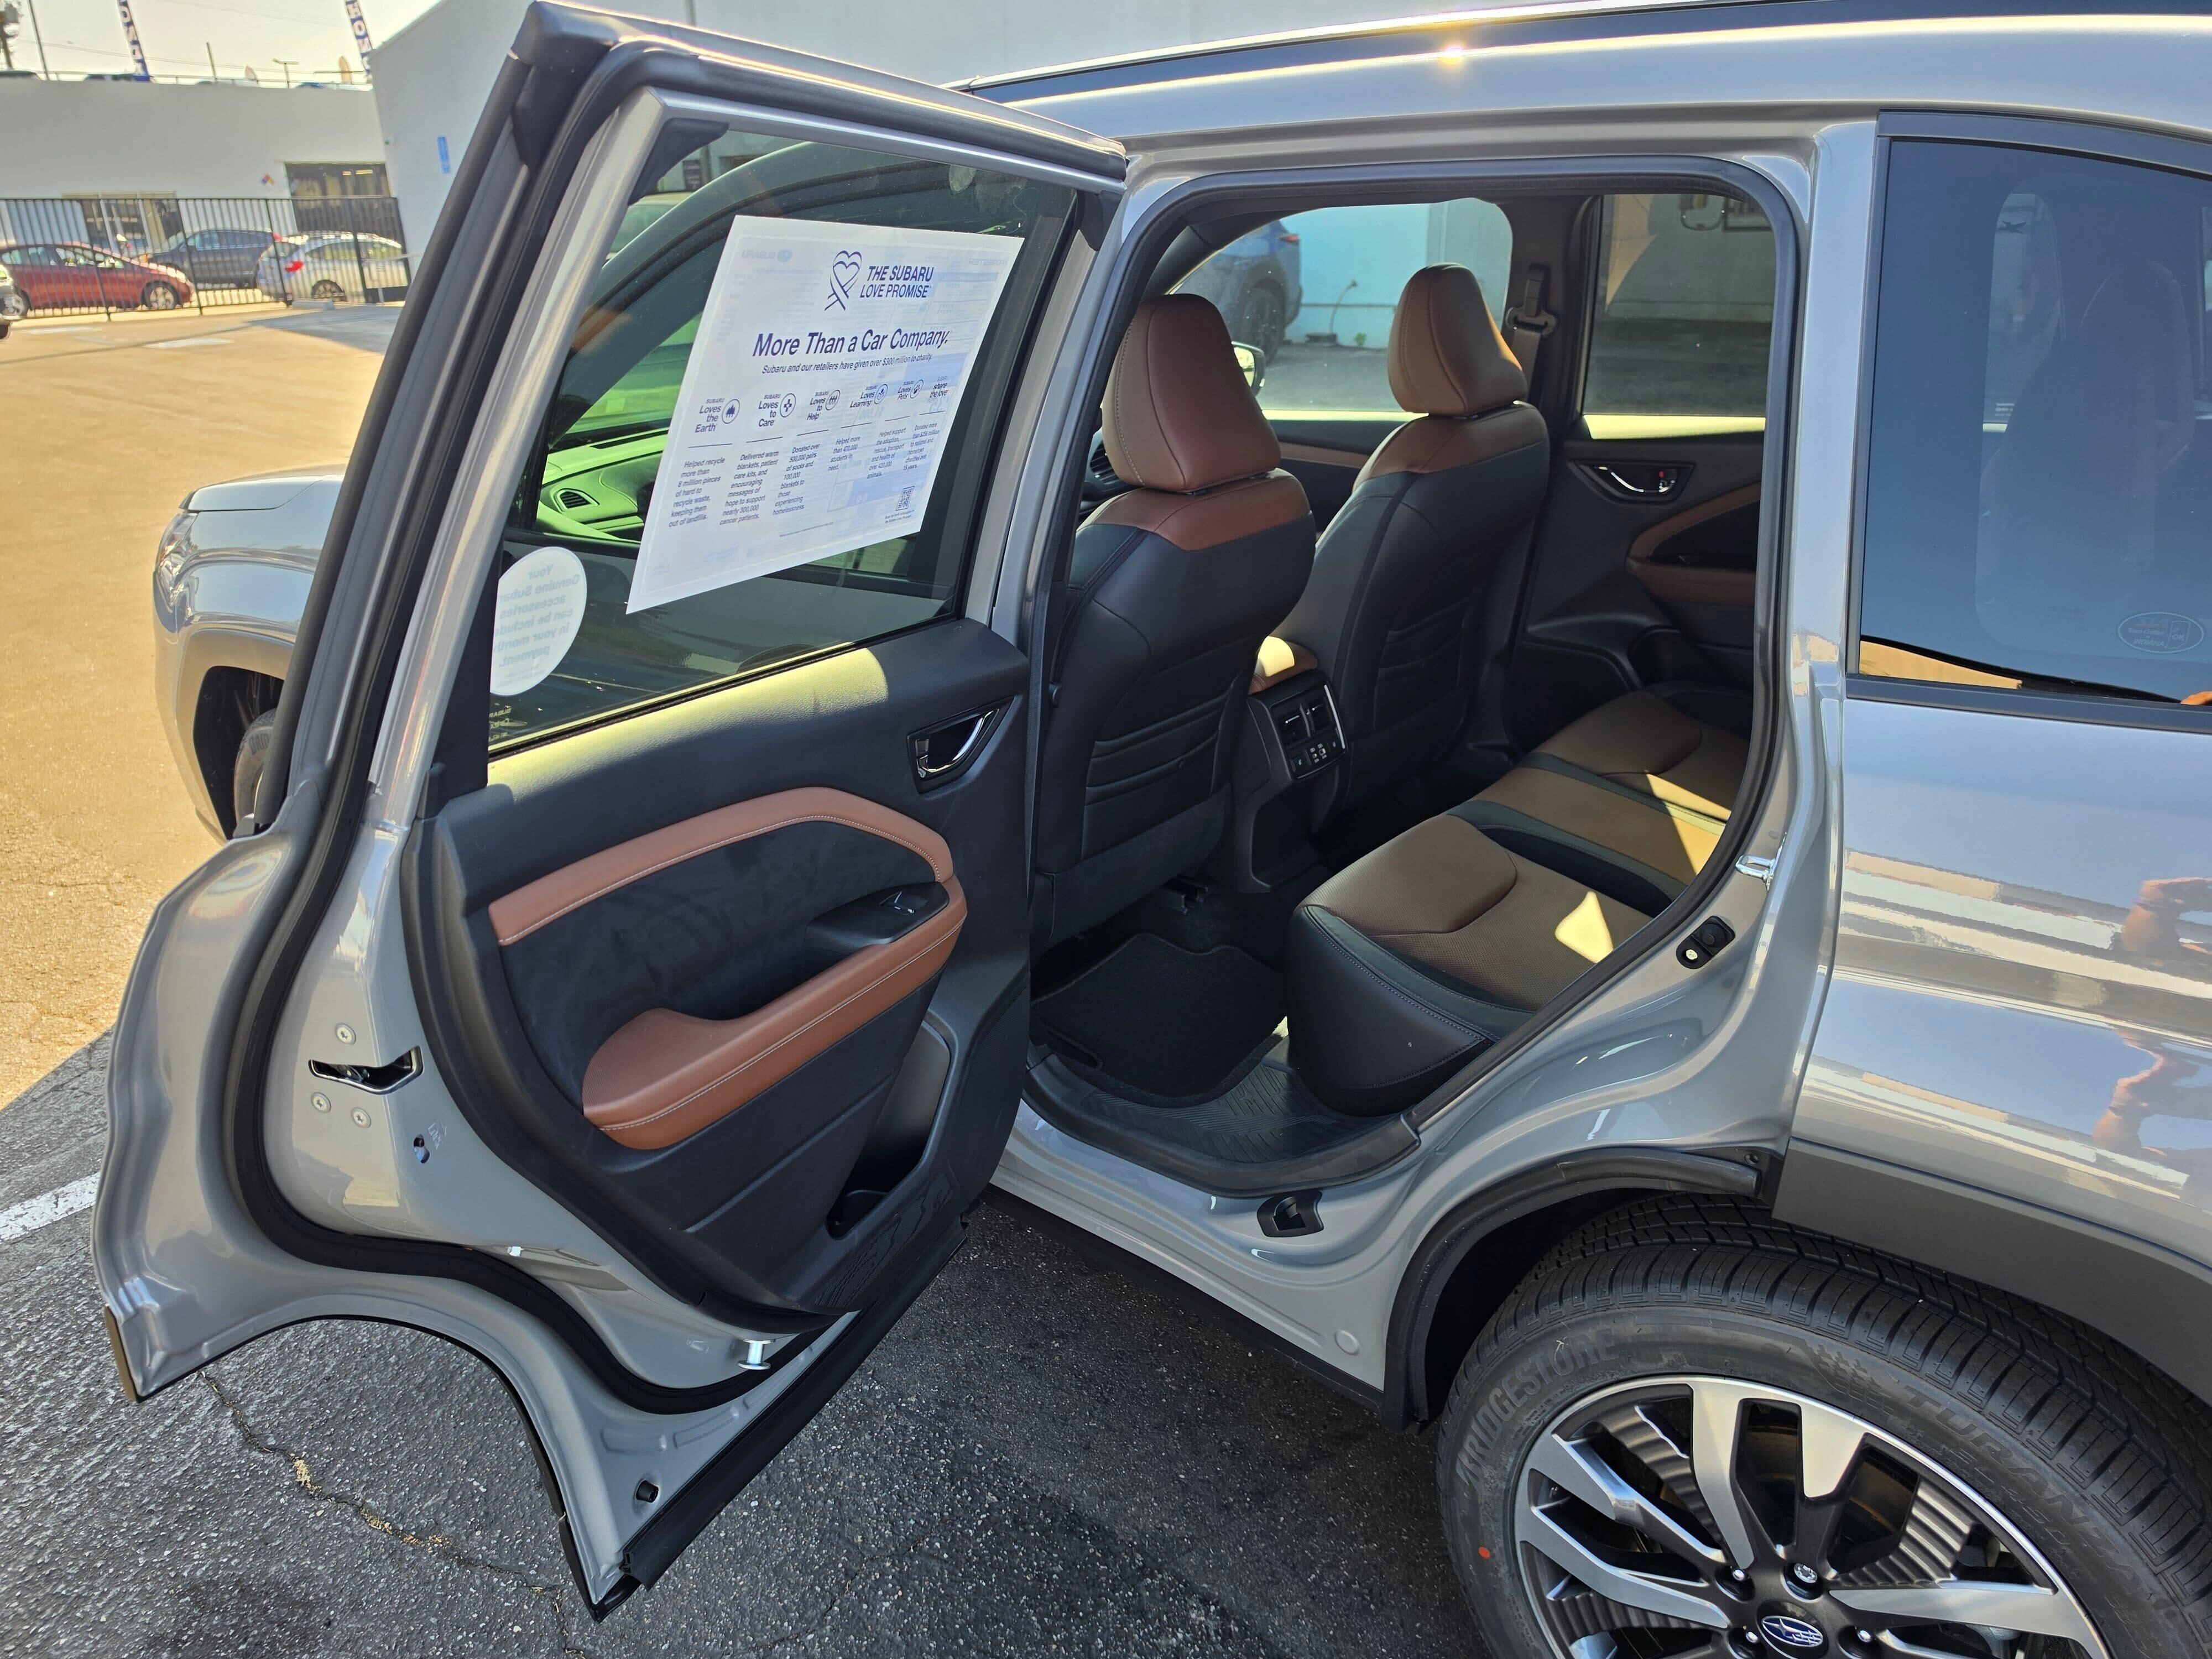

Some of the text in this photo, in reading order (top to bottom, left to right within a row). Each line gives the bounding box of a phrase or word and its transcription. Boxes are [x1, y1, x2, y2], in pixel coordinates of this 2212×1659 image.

[867, 265, 934, 282] THE SUBARU
[860, 284, 930, 299] LOVE PROMISE
[752, 328, 950, 357] More Than a Car Company.
[762, 364, 786, 374] Subaru
[787, 363, 801, 372] and
[813, 362, 838, 371] retailers
[839, 361, 853, 369] have
[854, 359, 869, 371] given
[883, 357, 895, 366] $300
[895, 355, 911, 364] million
[911, 354, 916, 362] to
[916, 352, 932, 362] charity.
[933, 382, 947, 390] share
[930, 388, 948, 398] the love
[758, 401, 779, 410] Loves
[810, 398, 826, 406] Loves
[850, 399, 873, 409] Learning
[699, 405, 722, 414] Loves
[769, 410, 777, 418] to
[706, 413, 719, 422] the
[806, 412, 820, 421] Help
[695, 422, 716, 433] Earth
[758, 418, 774, 427] Care
[915, 423, 928, 431] Donated
[879, 426, 907, 437] Helped support
[836, 436, 850, 446] Helped
[792, 444, 811, 453] Donated
[740, 452, 765, 461] Delivered
[806, 452, 817, 461] pairs
[830, 454, 848, 463] students
[879, 453, 890, 461] health
[684, 457, 725, 468] Helped recycle
[737, 459, 779, 470] blankets, patient
[792, 462, 805, 471] socks
[682, 478, 702, 487] million
[702, 476, 721, 486] pieces
[731, 479, 763, 488] encouraging
[780, 481, 799, 489] blankets
[675, 489, 682, 497] of
[682, 487, 696, 496] hard
[727, 488, 754, 498] messages
[673, 497, 693, 508] recycle
[745, 494, 766, 504] support
[775, 495, 804, 508] experiencing
[671, 508, 693, 518] keeping
[722, 508, 739, 517] nearly
[669, 519, 679, 528] out
[679, 517, 686, 526] of
[719, 517, 738, 525] cancer
[2132, 637, 2166, 647] INDIANA
[2172, 634, 2185, 642] OK
[1455, 1328, 1621, 1490] BRIDGESTONE
